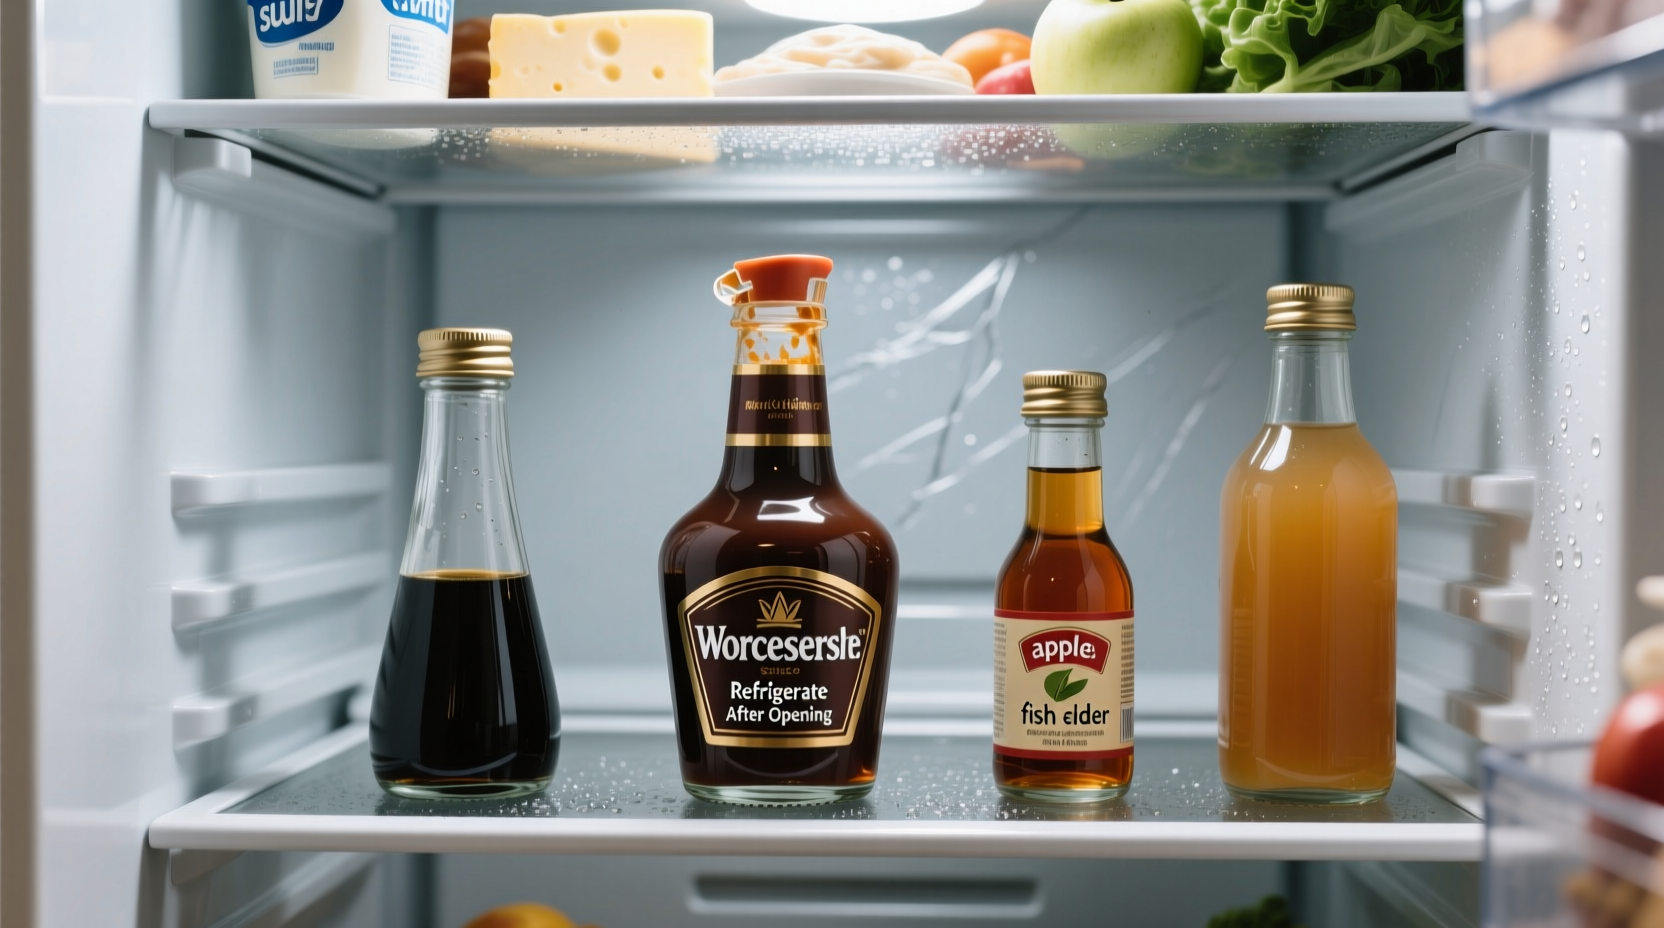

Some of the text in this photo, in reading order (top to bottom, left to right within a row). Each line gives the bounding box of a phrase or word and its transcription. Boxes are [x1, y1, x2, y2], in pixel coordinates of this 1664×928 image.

[731, 681, 828, 704] Refrigerate
[726, 705, 833, 726] After Opening
[1021, 701, 1056, 725] fish
